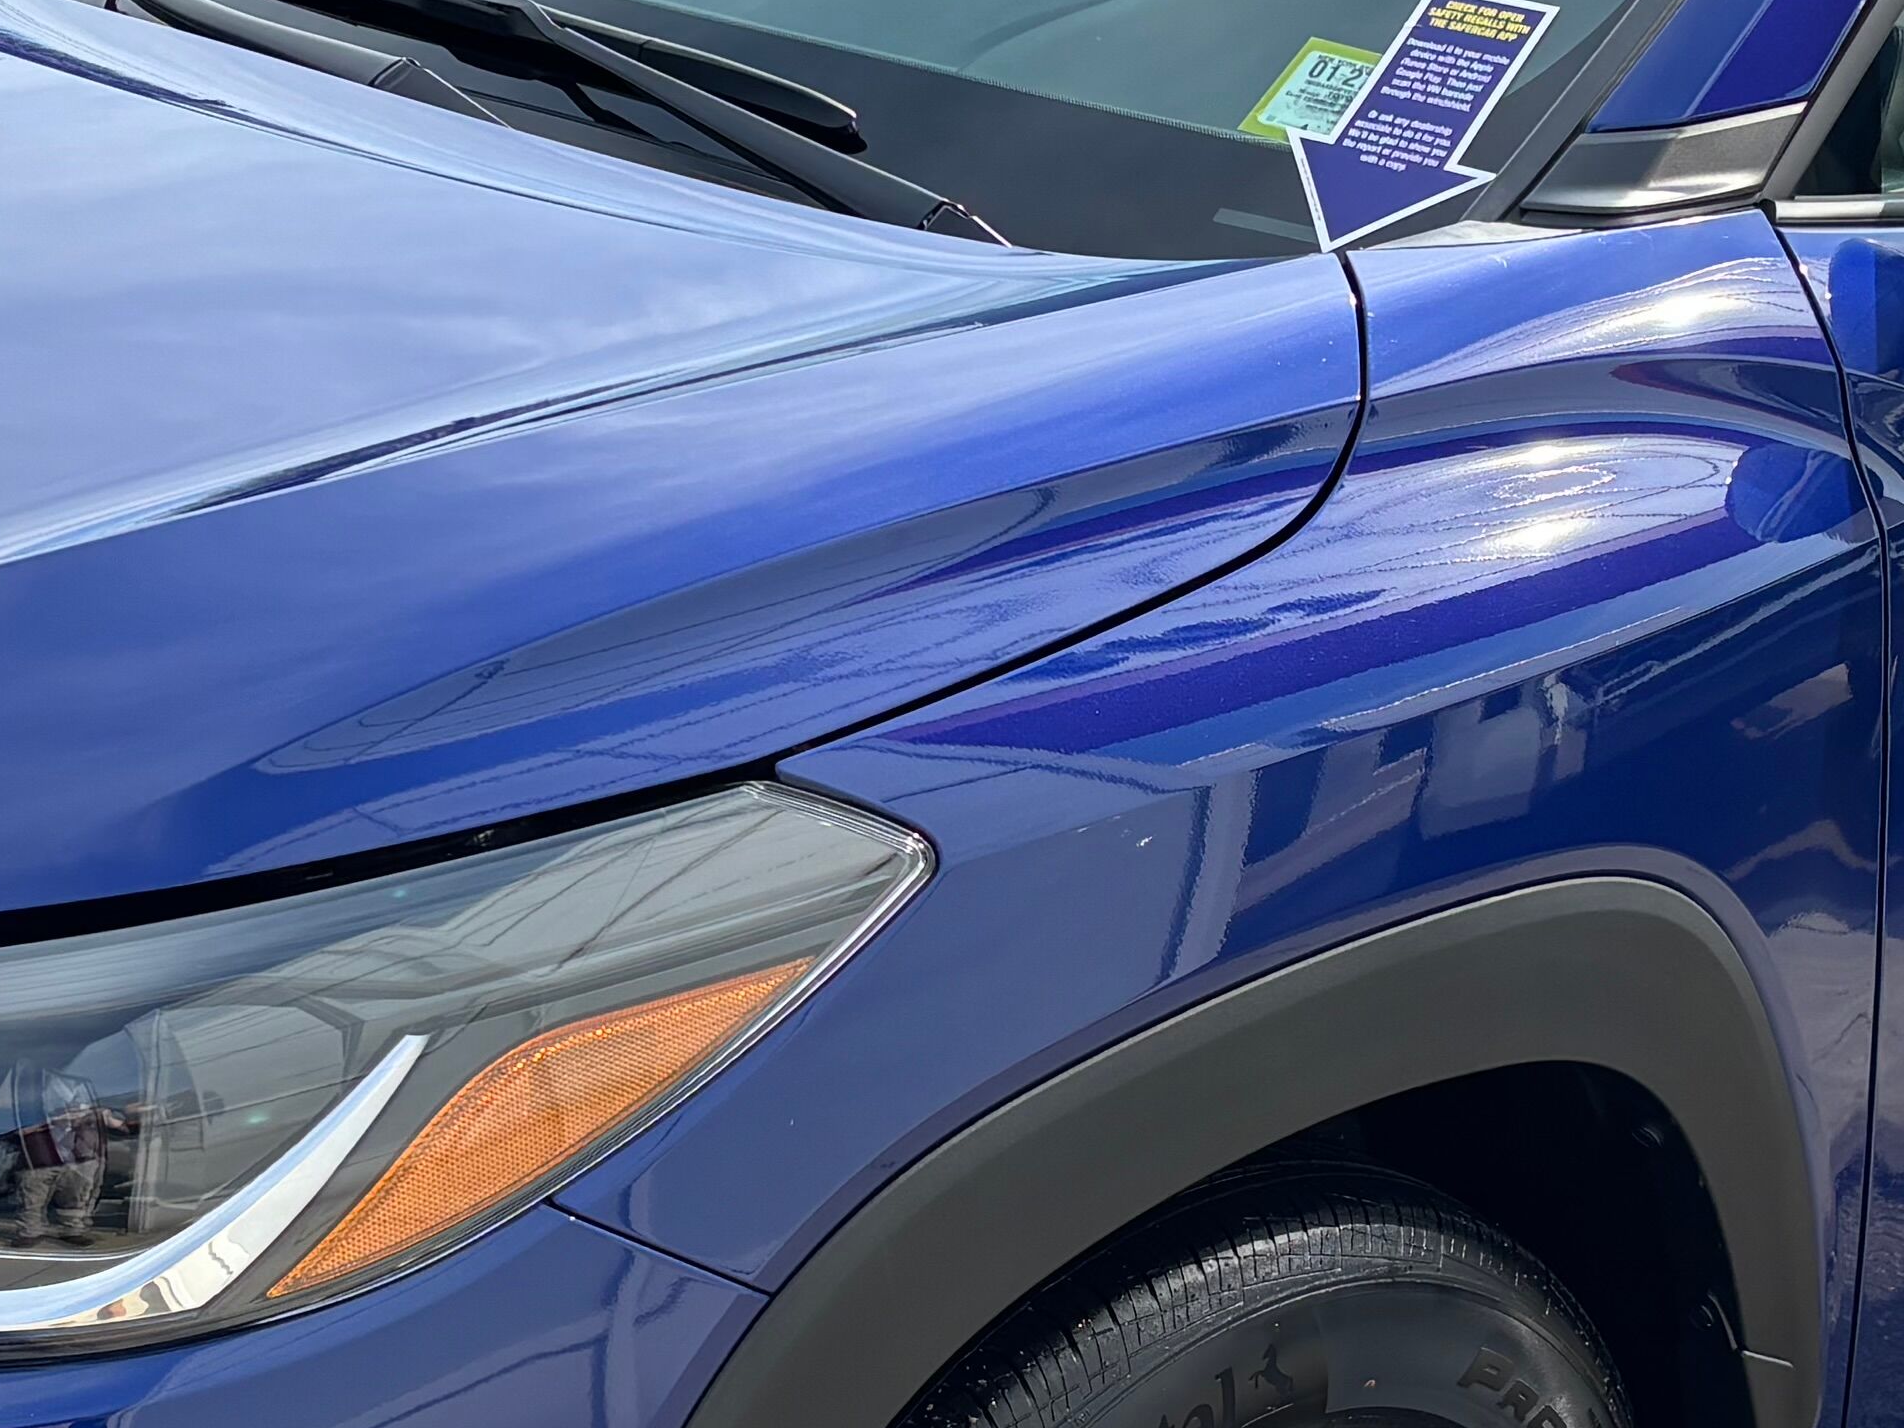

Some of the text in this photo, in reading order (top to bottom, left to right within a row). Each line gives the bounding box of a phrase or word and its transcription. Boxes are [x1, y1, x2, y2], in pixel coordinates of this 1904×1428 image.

[1428, 7, 1464, 20] SAFETY
[1505, 22, 1531, 34] WITH
[1429, 17, 1449, 29] THE
[1496, 30, 1518, 42] APP
